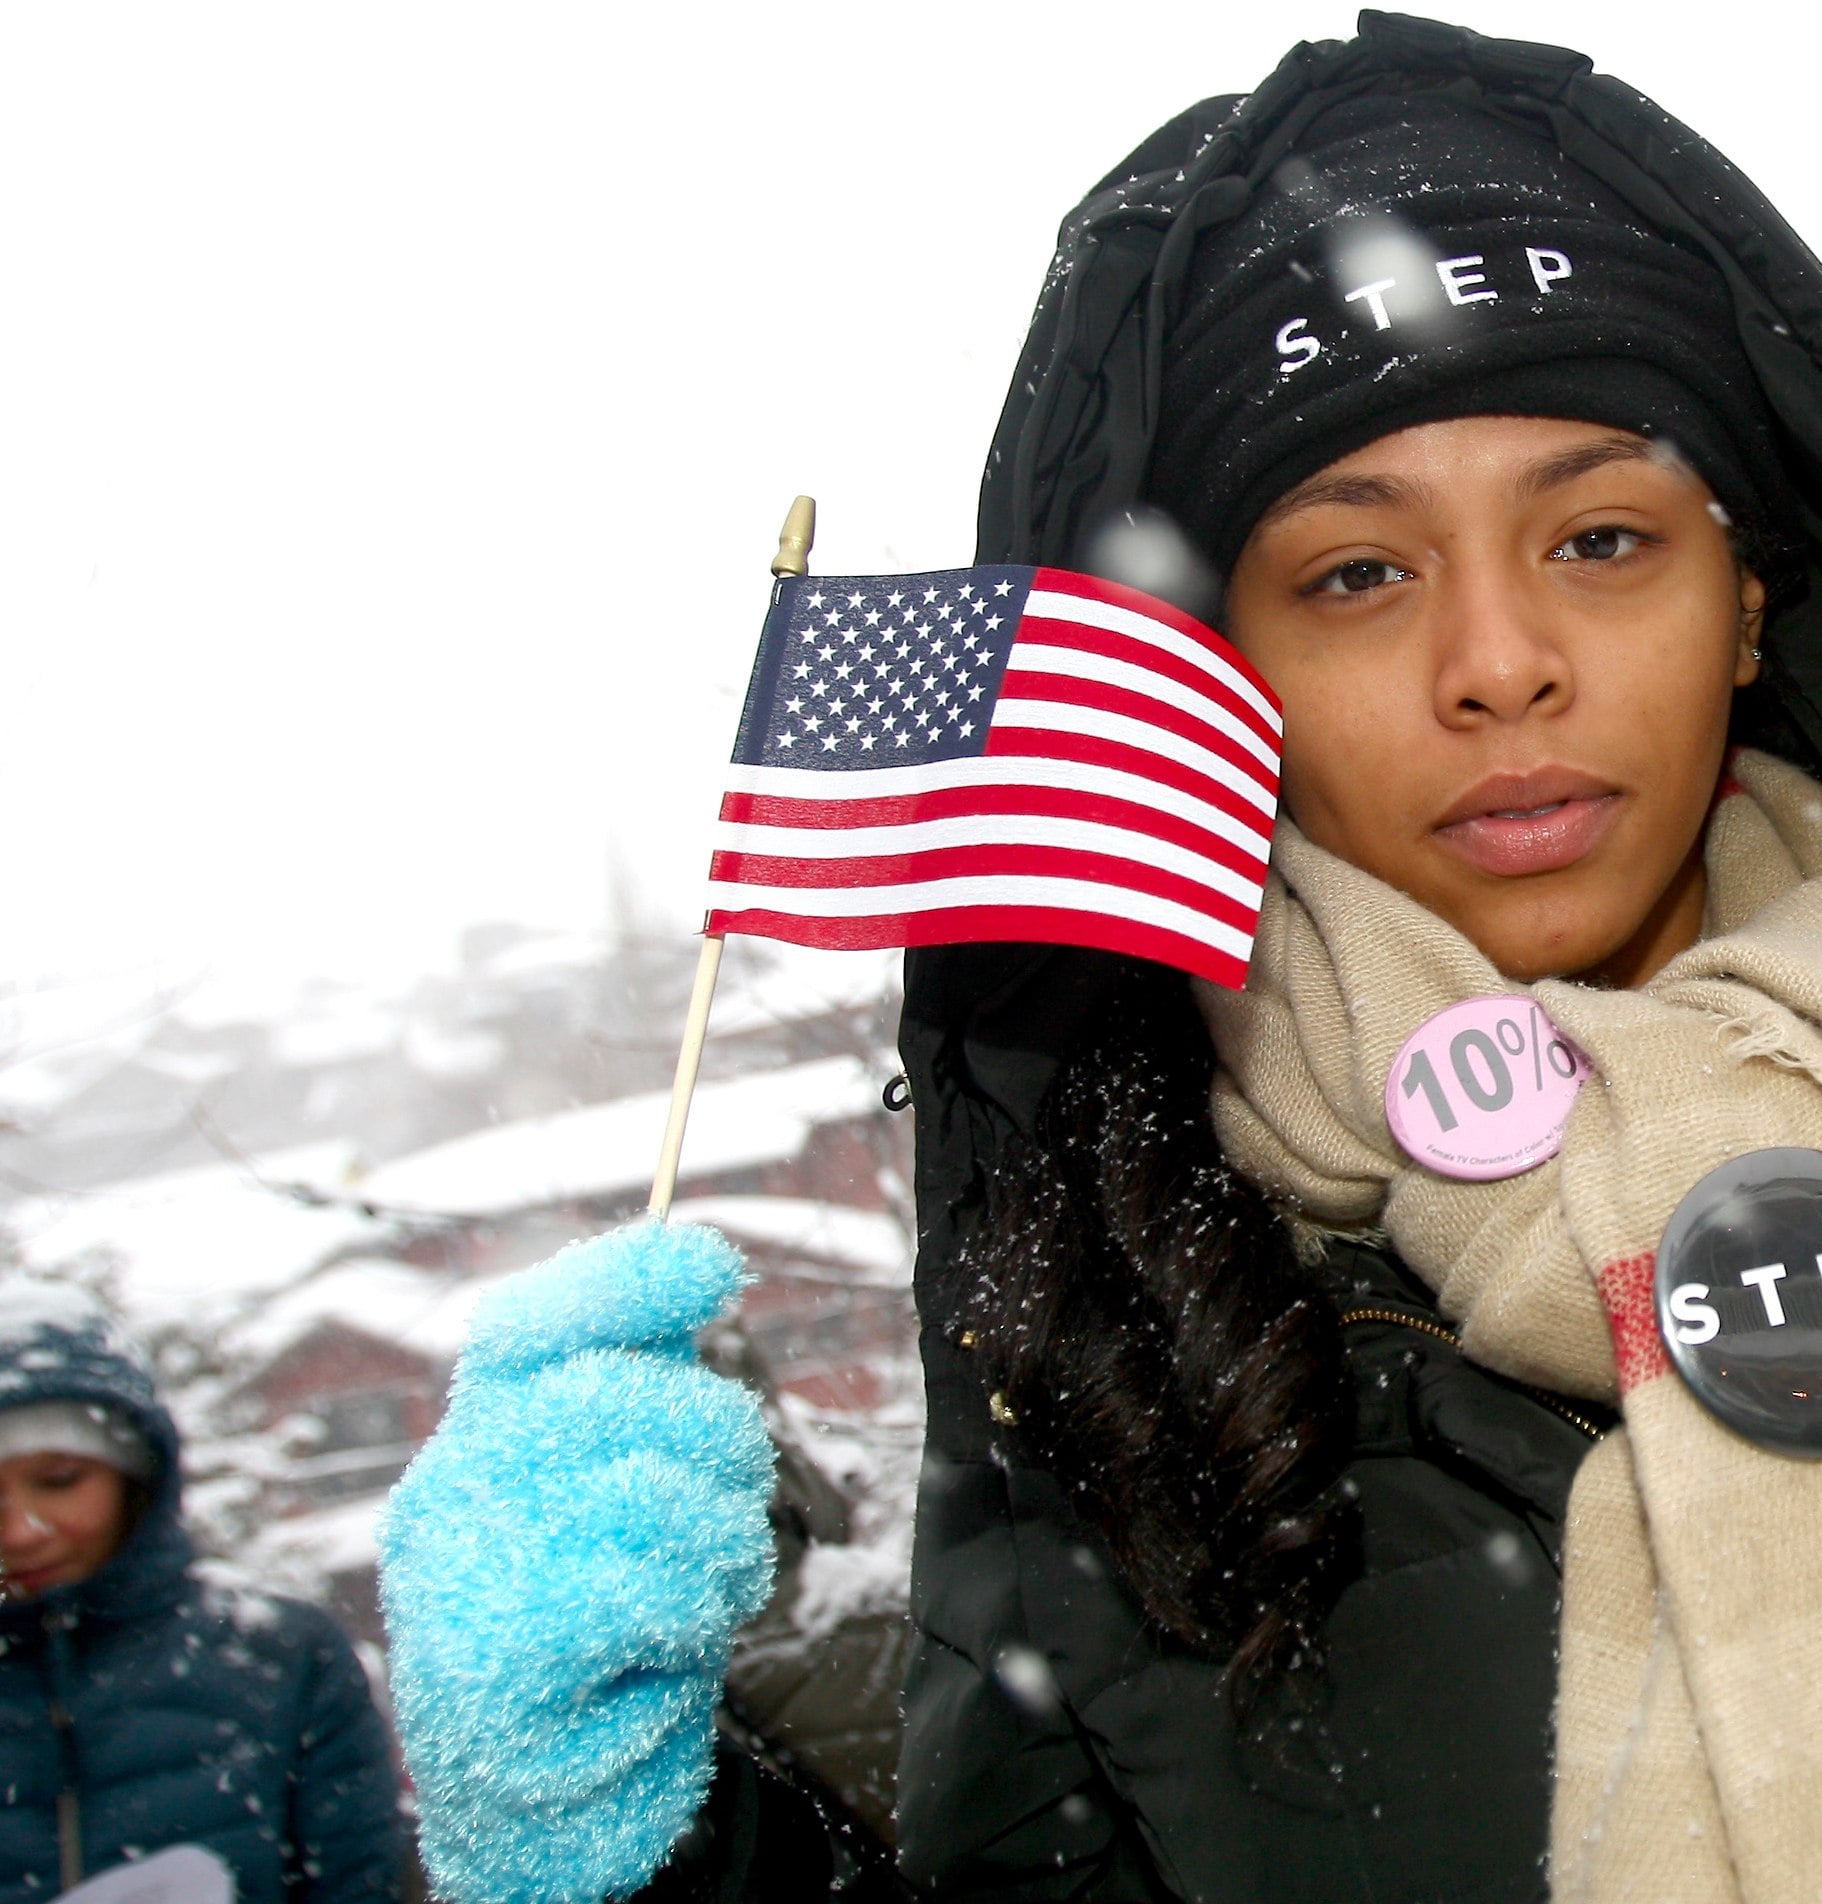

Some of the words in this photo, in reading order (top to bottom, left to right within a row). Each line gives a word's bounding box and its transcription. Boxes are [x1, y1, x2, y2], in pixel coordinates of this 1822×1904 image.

[1275, 247, 1573, 373] STEP
[1401, 1006, 1577, 1133] 10%
[1457, 1155, 1469, 1164] TV
